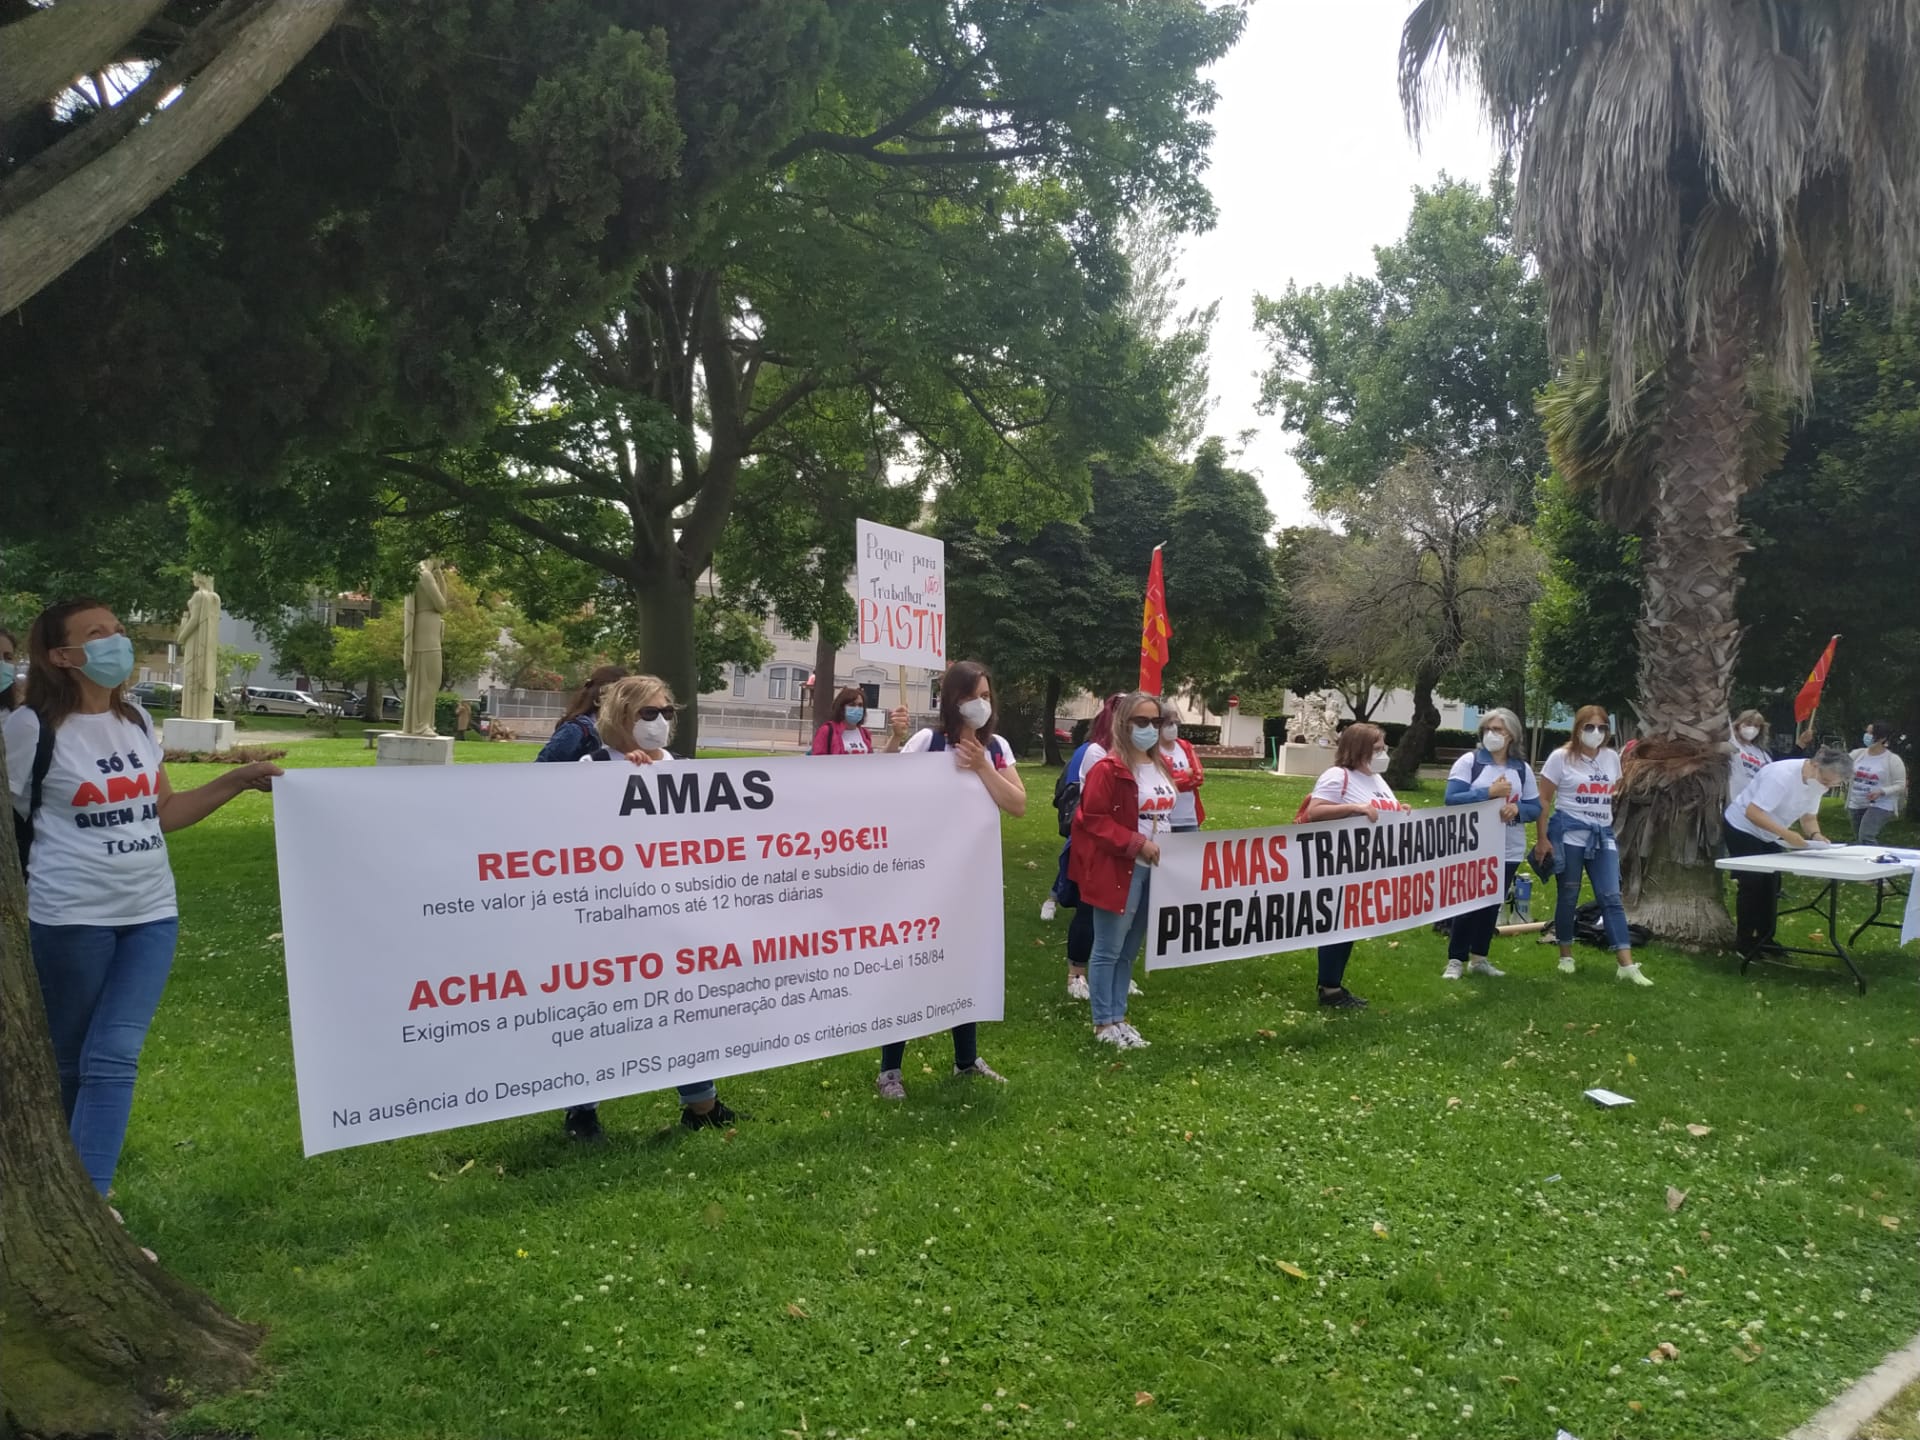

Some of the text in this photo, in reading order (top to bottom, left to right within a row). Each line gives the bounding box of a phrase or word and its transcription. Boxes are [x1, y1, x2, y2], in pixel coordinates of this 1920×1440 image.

[866, 533, 936, 574] Pagar para
[860, 598, 944, 657] BASTA!
[71, 771, 160, 807] AM
[96, 749, 144, 774] SÓ É
[619, 770, 774, 816] AMAS
[478, 826, 888, 881] RECIBO VERDE 762,96€!!
[1201, 812, 1478, 891] AMAS TRABALHADORAS
[423, 858, 925, 916] neste valor já está incluído o subsídio de natal e subsídio de férias
[574, 886, 823, 924] Trabalhamos até 12 horas diárias
[1440, 857, 1497, 907] VERDES
[408, 917, 941, 1011] ACHA JUSTO SRA MINISTRA???
[403, 949, 944, 1043] Exigimos a publicação em DR do Despacho previsto no Dec-Lei 158/84
[552, 987, 852, 1047] que atualiza a Remuneração das Amas.
[333, 998, 976, 1128] Na ausência do Despacho, as IPSS pagam seguindo os critérios das suas Direcções.
